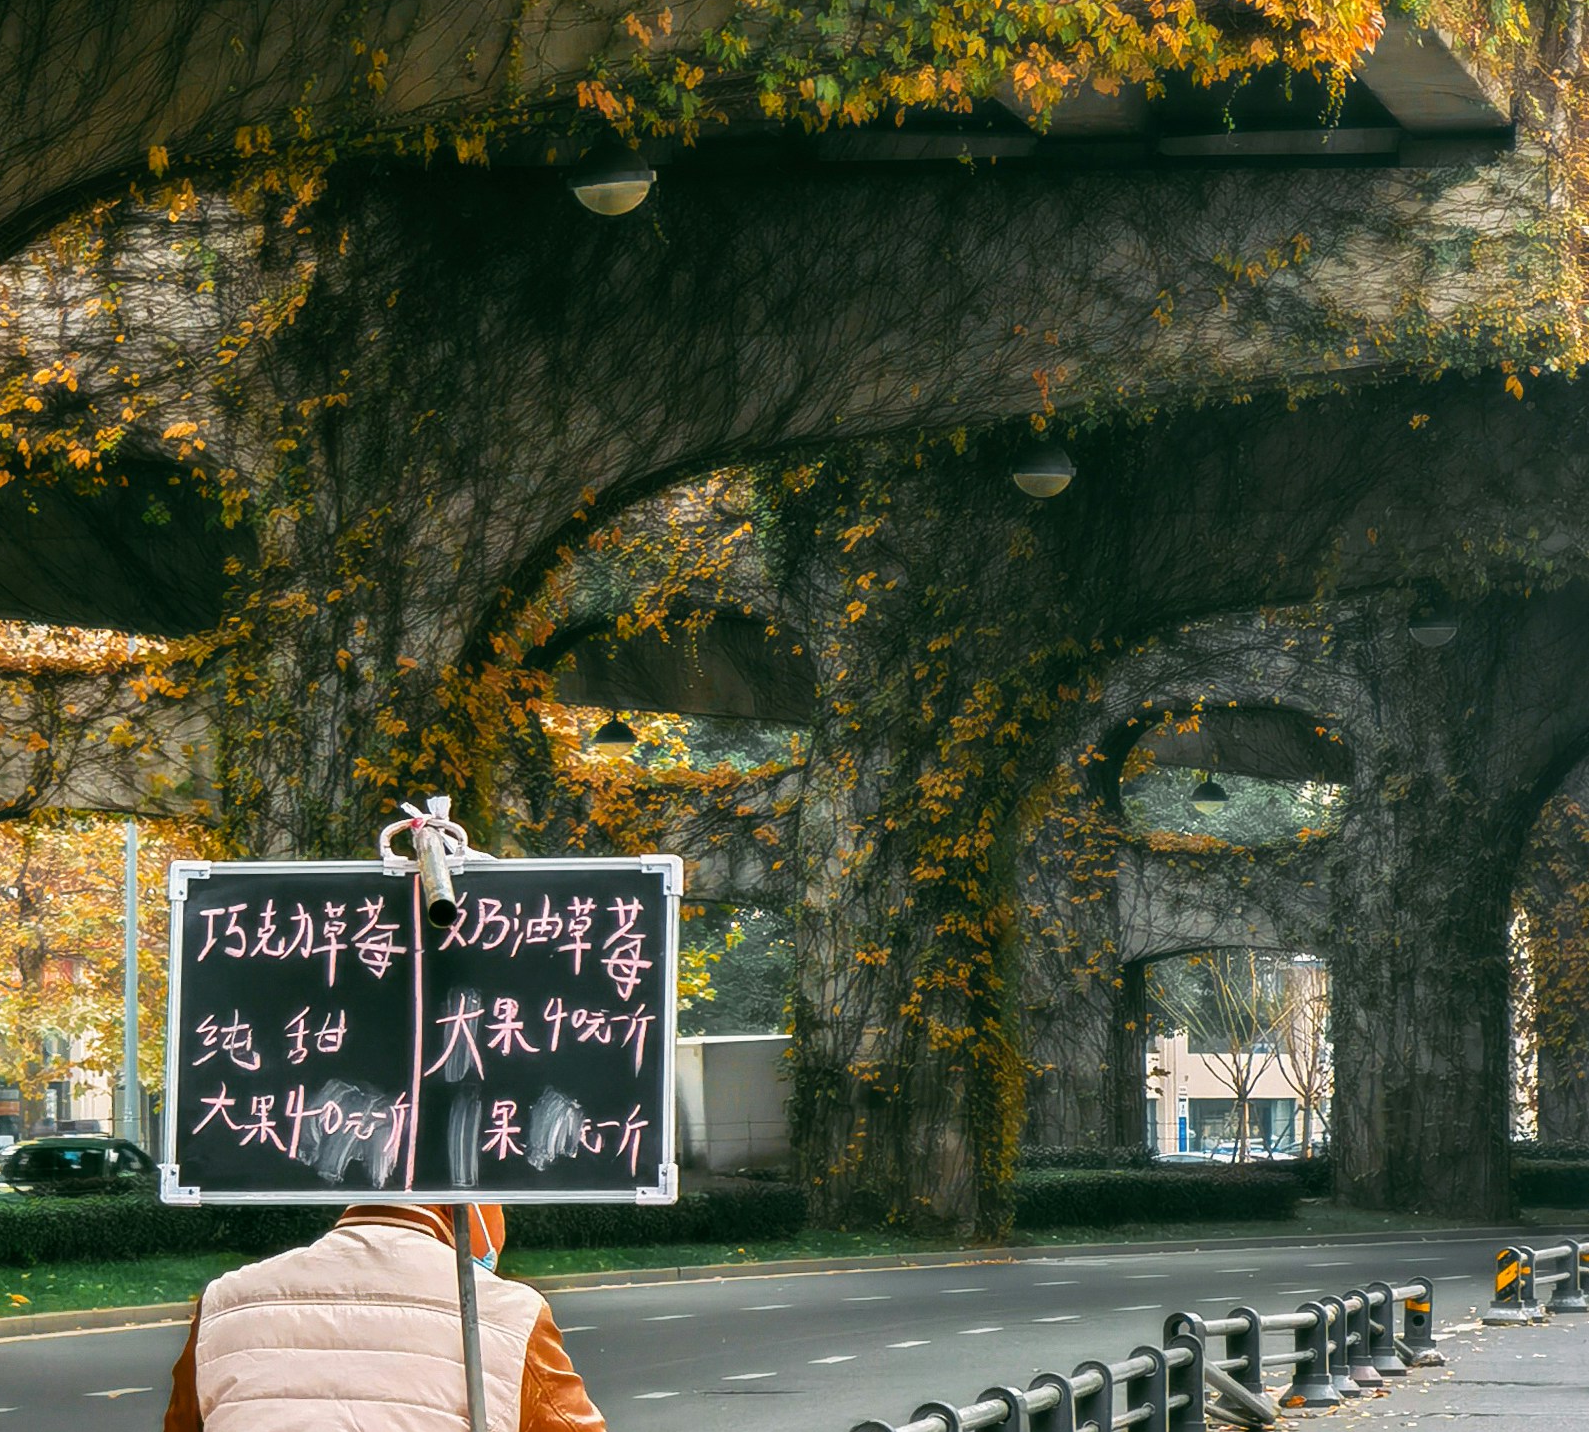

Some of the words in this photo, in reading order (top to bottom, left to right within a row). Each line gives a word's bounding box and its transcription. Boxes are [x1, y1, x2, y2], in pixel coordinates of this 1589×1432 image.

[197, 895, 406, 987] 巧克力草莓
[438, 890, 653, 1001] 奶油草莓
